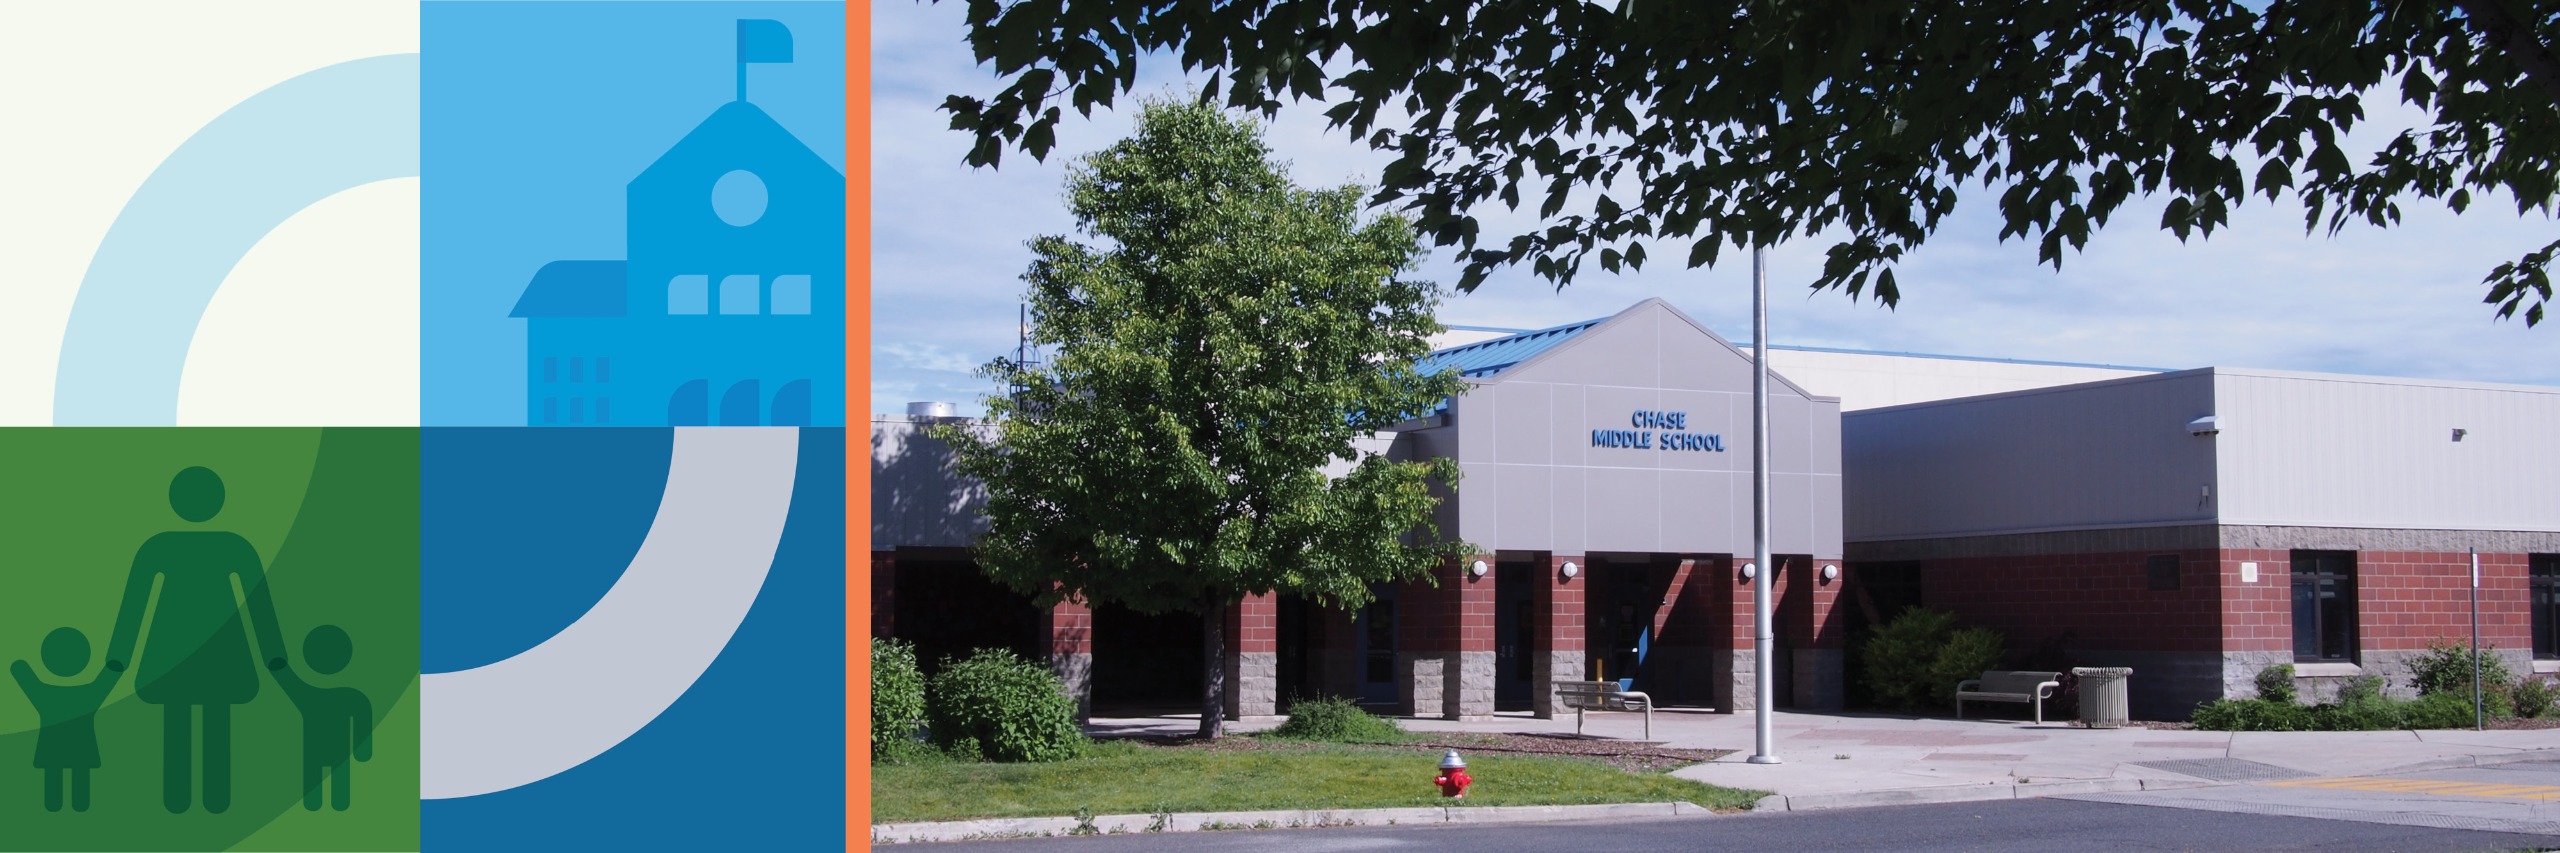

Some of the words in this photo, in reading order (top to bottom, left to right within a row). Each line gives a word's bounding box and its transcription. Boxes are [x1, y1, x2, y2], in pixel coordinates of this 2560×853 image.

[1631, 409, 1687, 430] CHASE
[1591, 429, 1652, 449] MIDDLE
[1659, 432, 1725, 452] SCHOOL
